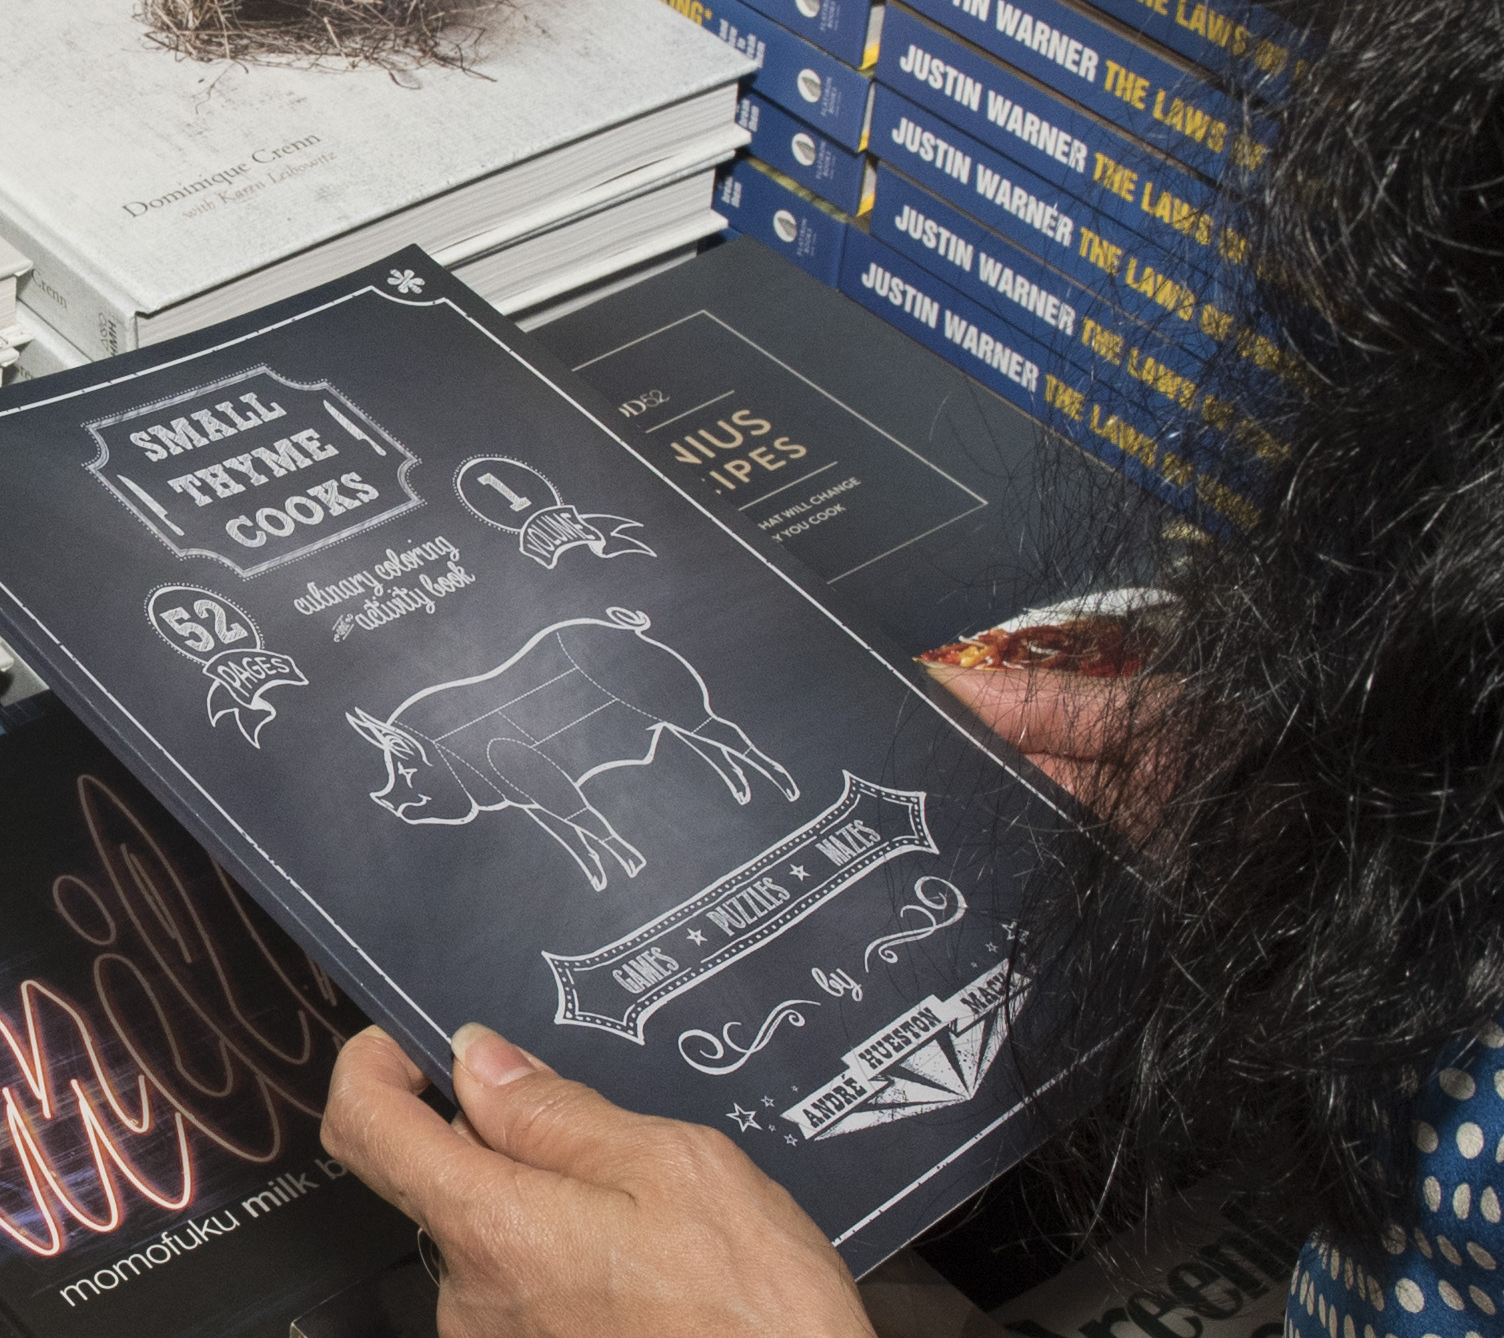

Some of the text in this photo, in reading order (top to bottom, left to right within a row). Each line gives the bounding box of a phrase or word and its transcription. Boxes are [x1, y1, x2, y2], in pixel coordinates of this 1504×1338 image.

[130, 390, 288, 464] SMALL
[166, 428, 339, 509] THYME
[223, 471, 382, 549] COOKS
[162, 598, 247, 654] 52
[219, 654, 292, 699] PAGES
[60, 1174, 320, 1309] momofuku milk
